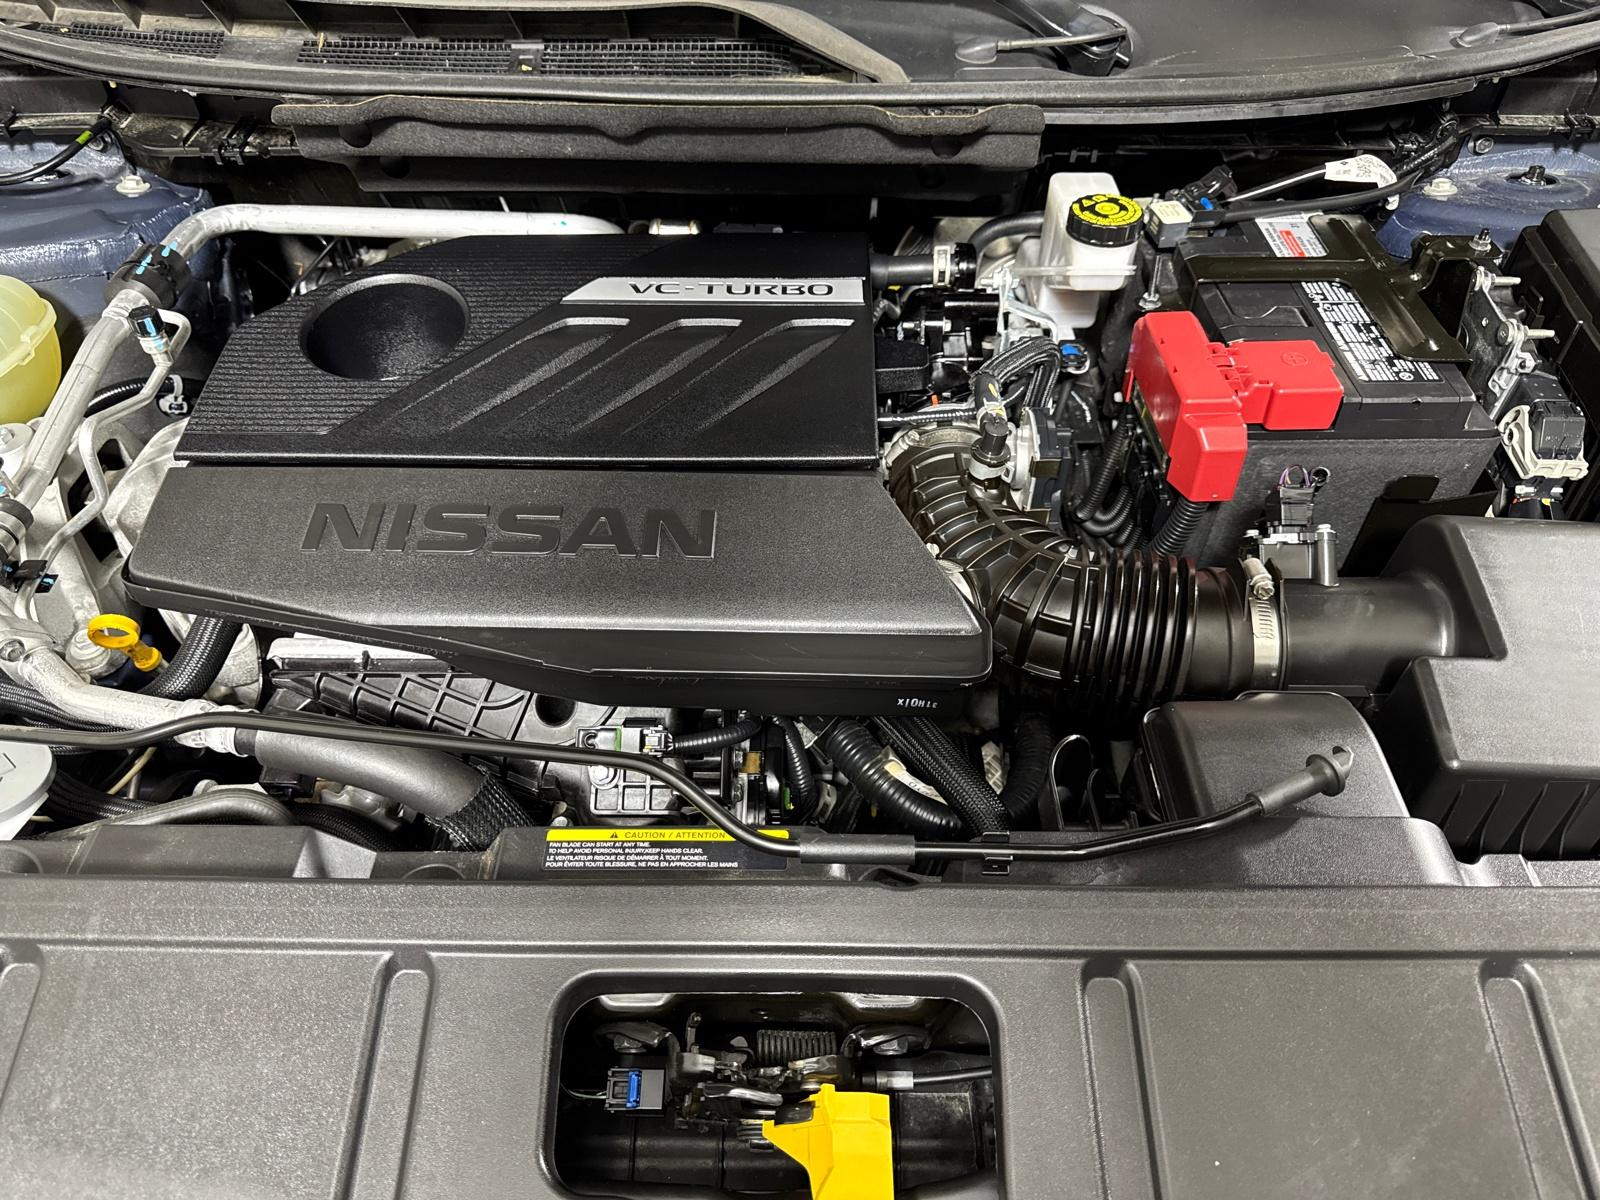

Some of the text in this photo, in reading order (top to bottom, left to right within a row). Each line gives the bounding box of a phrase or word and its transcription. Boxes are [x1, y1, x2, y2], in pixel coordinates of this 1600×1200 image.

[628, 281, 835, 298] VC-TURBO
[300, 502, 718, 560] NISSAN
[624, 831, 666, 840] CAUTION
[675, 831, 726, 840] ATTENTION
